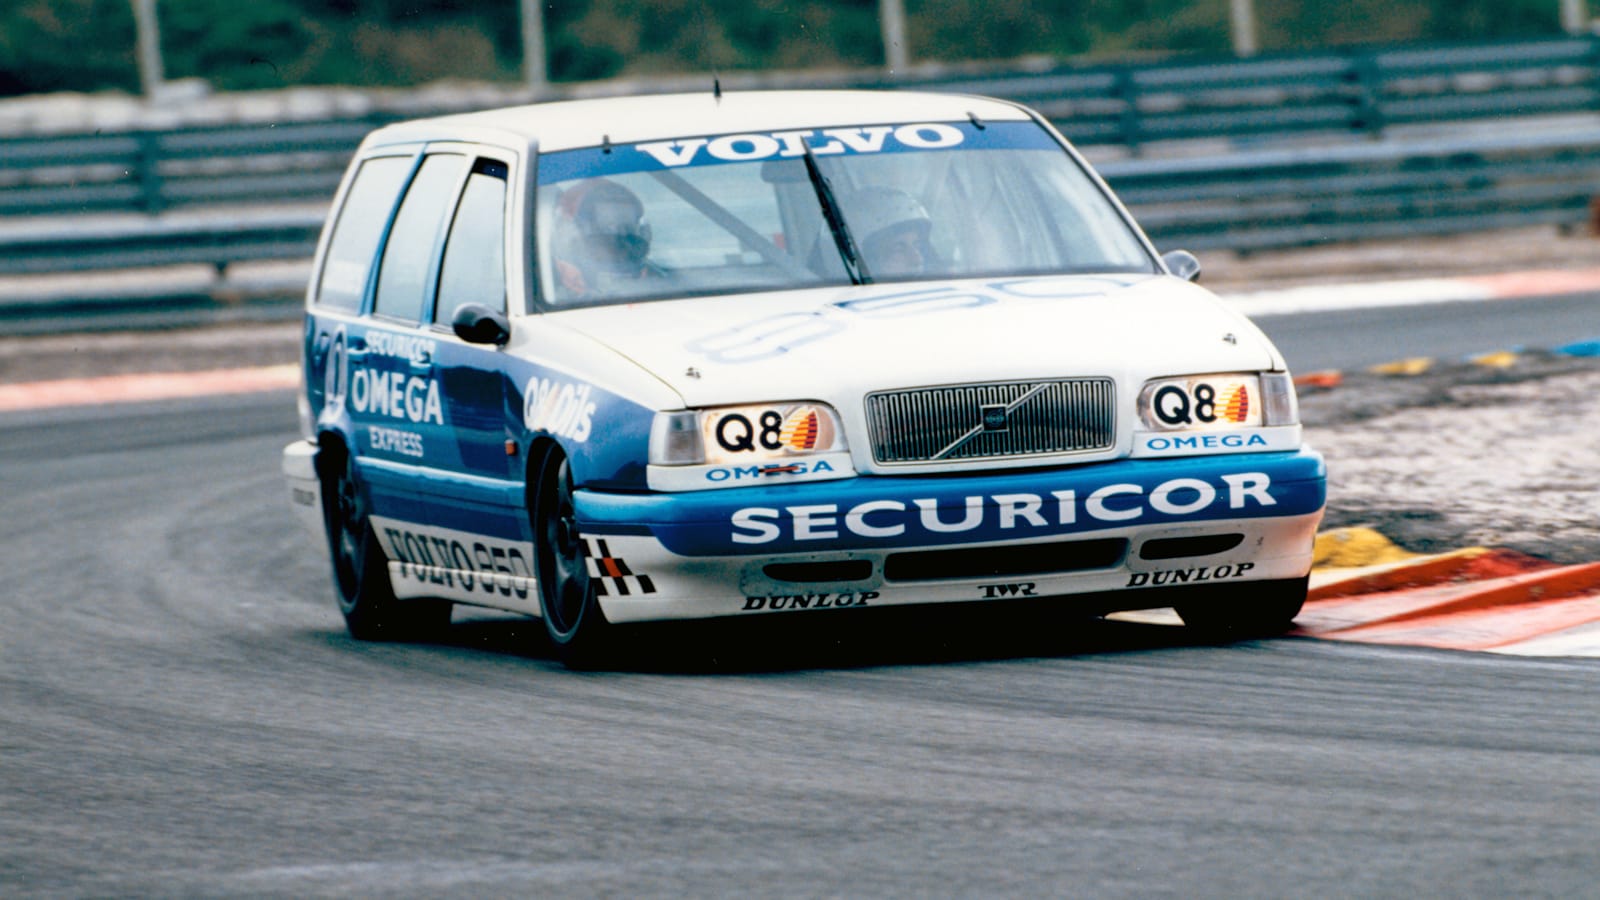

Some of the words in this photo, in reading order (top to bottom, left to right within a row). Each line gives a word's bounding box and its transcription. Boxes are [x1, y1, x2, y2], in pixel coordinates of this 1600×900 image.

[635, 123, 965, 167] VOLVO
[351, 368, 444, 425] OMEGA
[1153, 384, 1217, 425] Q8
[369, 426, 424, 457] EXPRESS
[715, 411, 783, 452] Q8
[1147, 433, 1267, 451] OMEGA
[705, 460, 834, 482] OMEGA
[731, 472, 1277, 544] SECURICOR
[384, 527, 475, 592] VOLVO
[474, 542, 530, 600] 850
[1125, 562, 1255, 588] DUNLOP
[741, 591, 880, 611] DUNLOP
[977, 582, 1038, 599] TWR
